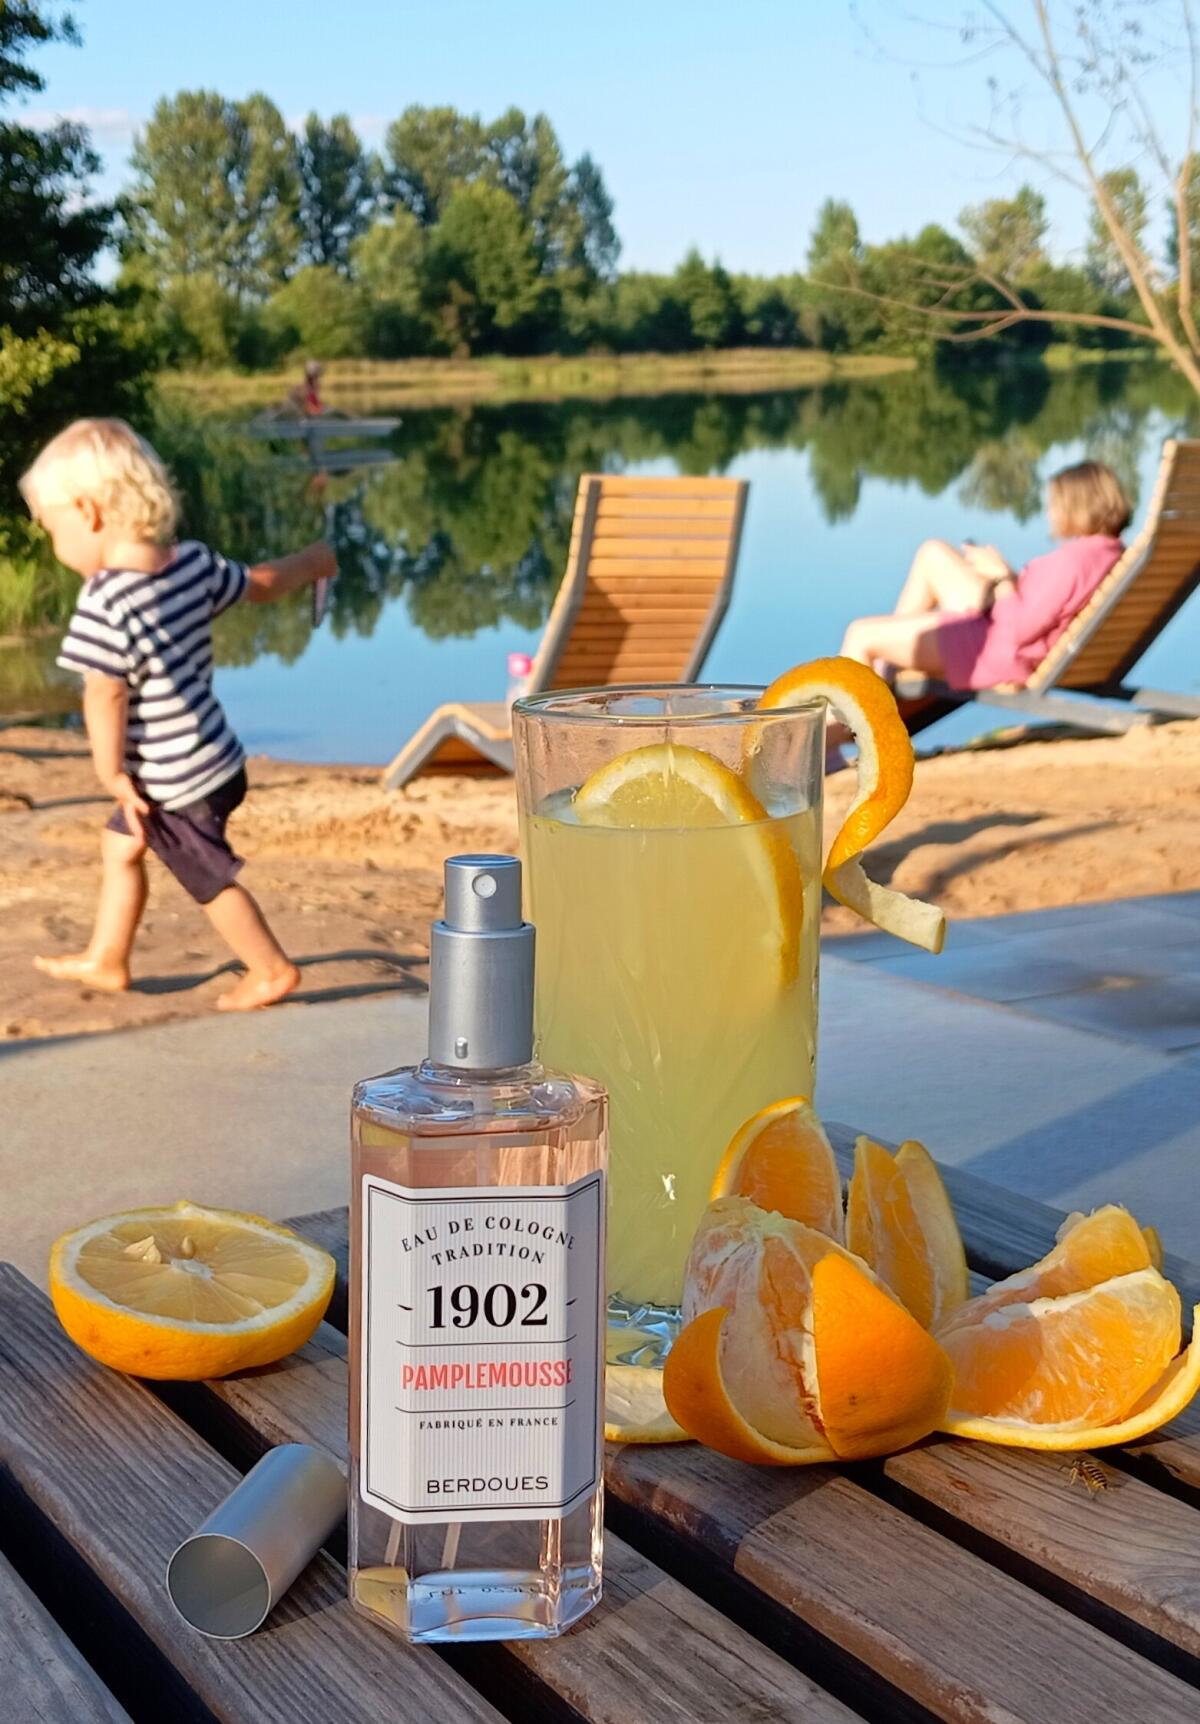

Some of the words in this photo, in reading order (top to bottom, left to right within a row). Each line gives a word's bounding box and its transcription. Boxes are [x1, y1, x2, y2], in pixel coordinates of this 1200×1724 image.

[401, 1227, 438, 1252] EAU
[449, 1218, 475, 1234] DE
[485, 1216, 575, 1250] COLOGNE
[431, 1243, 545, 1266] TRADITION
[426, 1283, 548, 1329] 1902
[402, 1359, 572, 1390] PAMPLEMOUSSE
[419, 1418, 483, 1430] FABRIQUÉ
[488, 1419, 504, 1428] EN
[510, 1417, 559, 1427] FRANCE
[427, 1476, 549, 1494] BERDOUES
